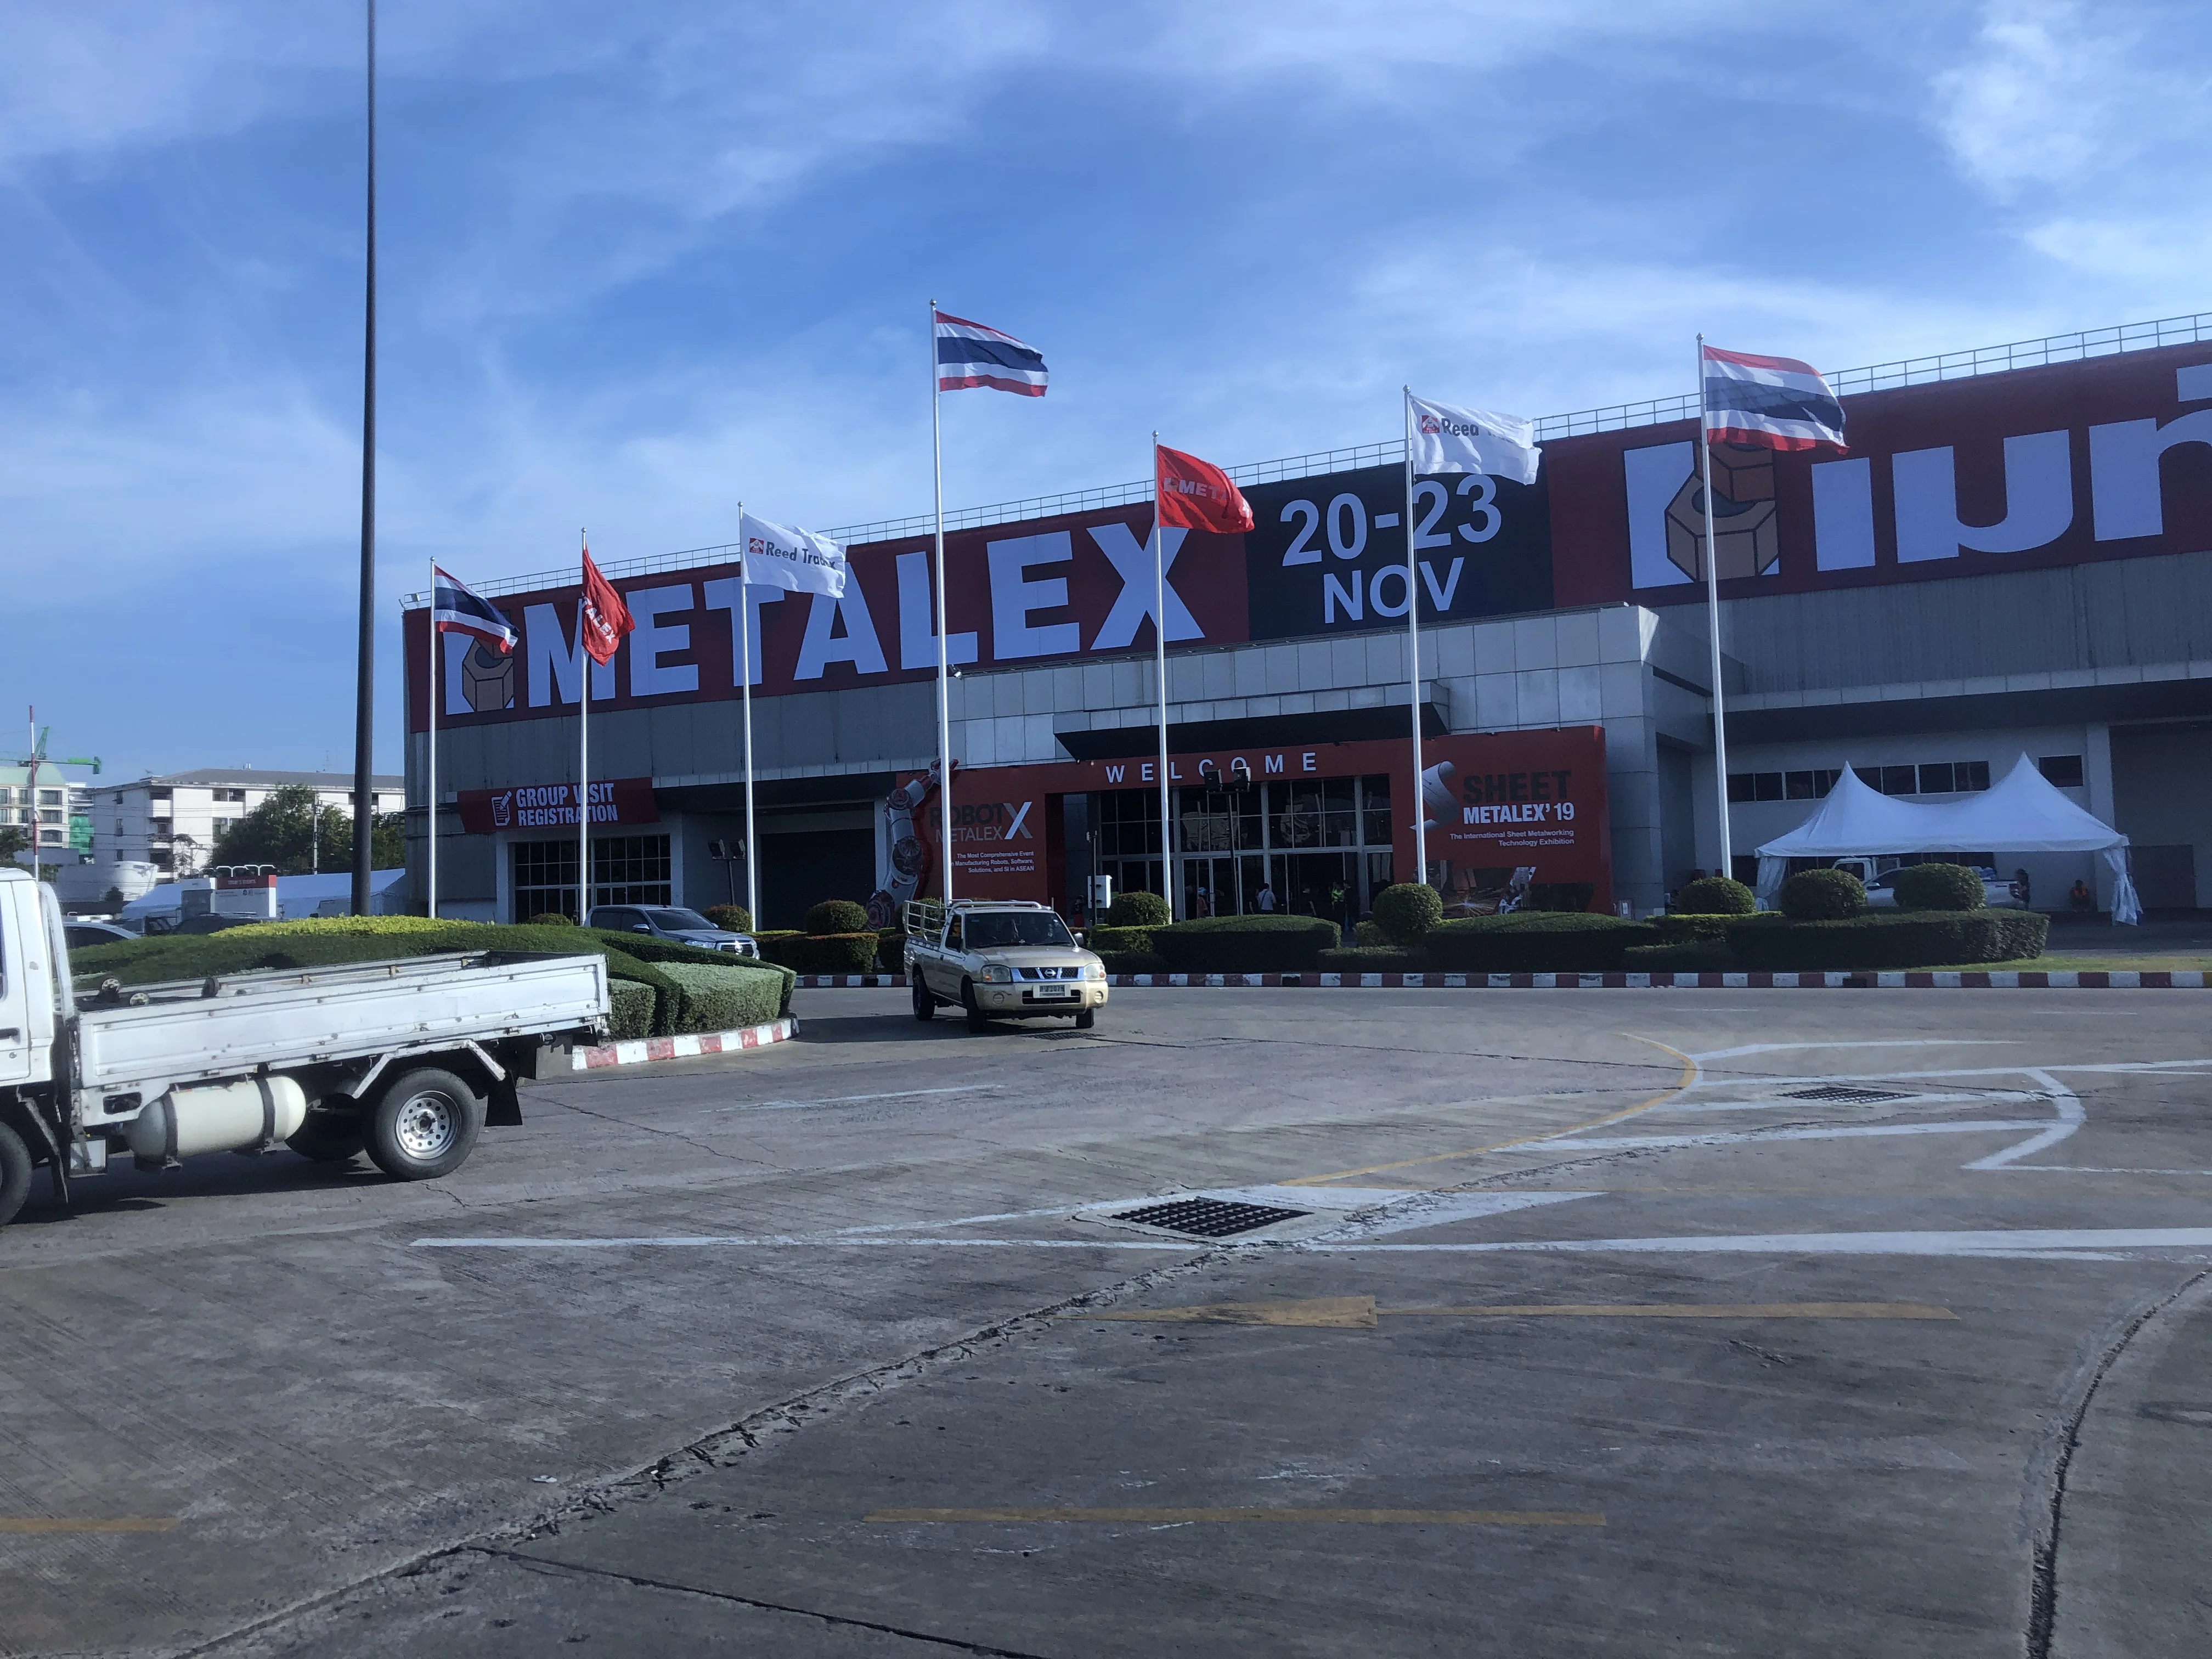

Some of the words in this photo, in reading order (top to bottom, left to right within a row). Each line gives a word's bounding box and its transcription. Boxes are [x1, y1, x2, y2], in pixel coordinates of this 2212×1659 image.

[1280, 474, 1502, 567] 20-23
[766, 541, 797, 561] Reed
[802, 548, 837, 570] Tradx
[1324, 556, 1464, 624] NOV
[523, 522, 1205, 708] METALEX
[516, 786, 568, 808] GROUP
[1463, 770, 1572, 804] SHEET
[518, 804, 618, 826] REGISTRATION
[1464, 831, 1505, 839] International
[1528, 829, 1574, 837] Metalworking
